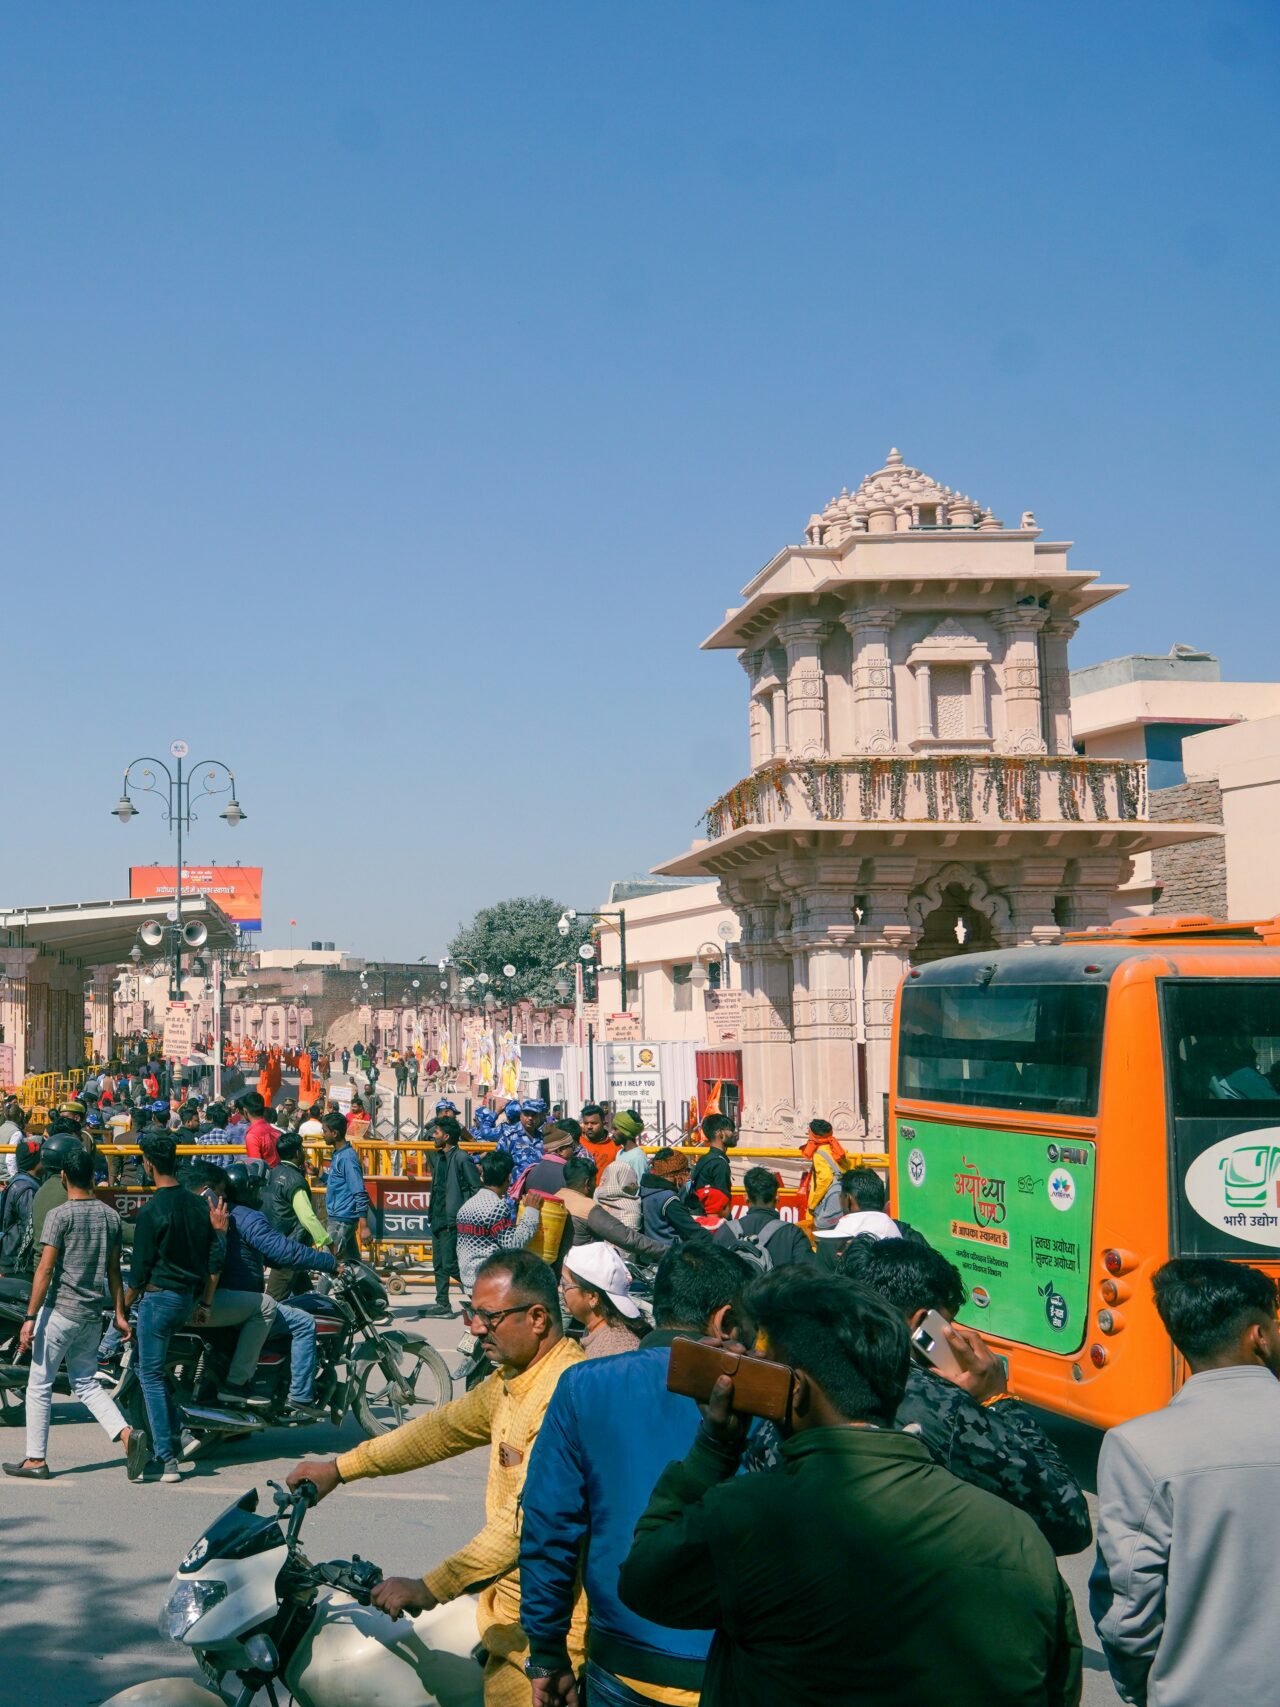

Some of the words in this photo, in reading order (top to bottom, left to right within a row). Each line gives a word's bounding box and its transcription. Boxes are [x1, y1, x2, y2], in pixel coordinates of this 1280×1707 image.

[953, 1157, 1005, 1204] अयोध्या
[383, 1191, 431, 1209] याता
[384, 1214, 431, 1231] जन
[1223, 1212, 1247, 1226] भारी
[1249, 1212, 1278, 1227] उद्योग
[959, 1226, 978, 1239] आपका
[979, 1230, 1001, 1243] स्वागत
[1002, 1232, 1008, 1246] है
[1035, 1236, 1051, 1250] स्वच्छ
[1053, 1238, 1075, 1255] अयोध्या
[1035, 1253, 1053, 1268] सुन्दर
[1054, 1255, 1075, 1271] अयोध्या
